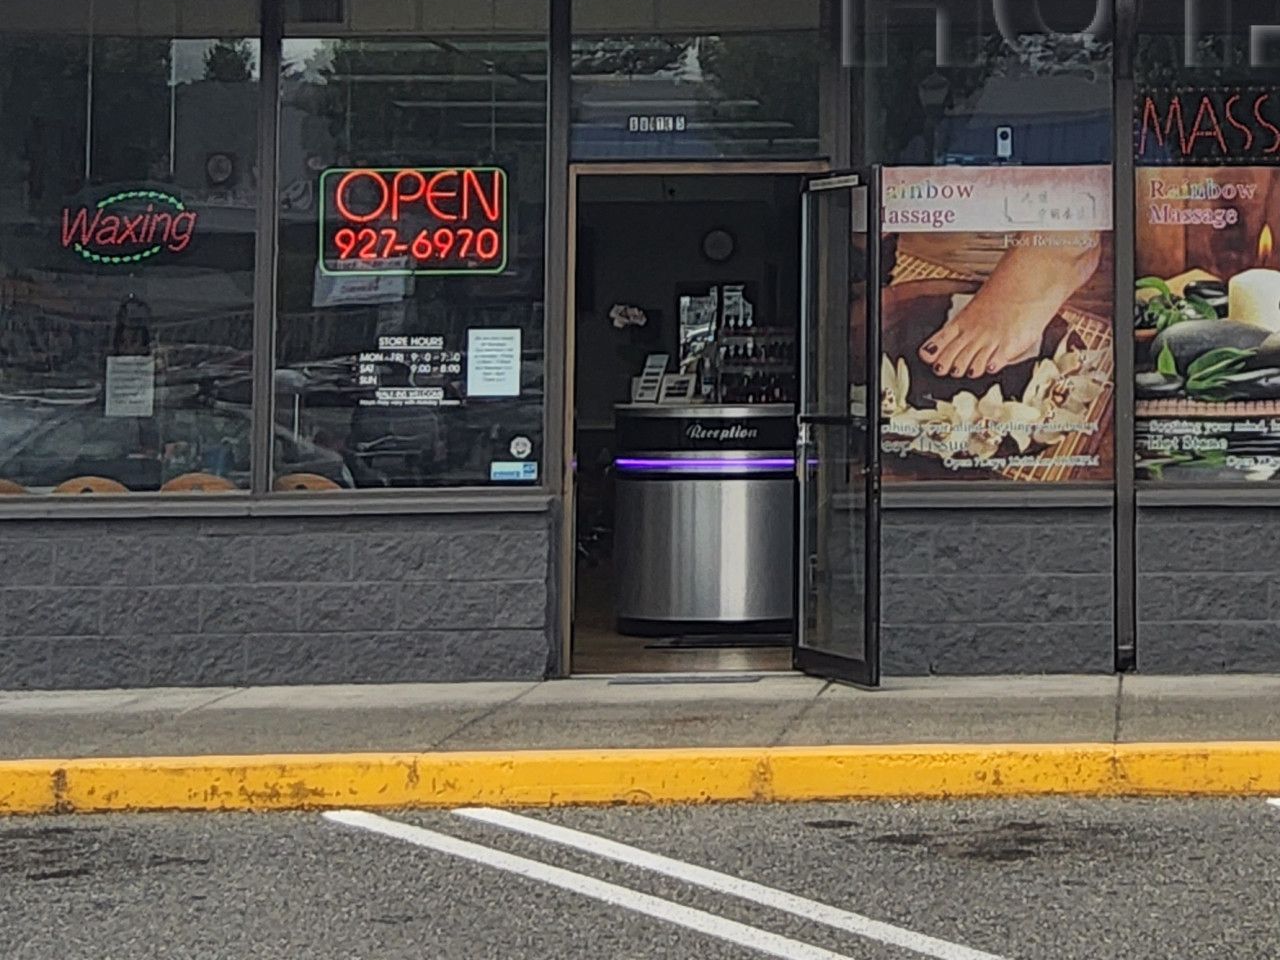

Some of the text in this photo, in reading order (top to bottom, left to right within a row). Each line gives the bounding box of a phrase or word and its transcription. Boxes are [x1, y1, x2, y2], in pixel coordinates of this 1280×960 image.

[336, 170, 499, 222] OPEN
[886, 180, 974, 200] ainbow
[1149, 177, 1257, 200] Rainbow
[61, 203, 197, 252] Waxing
[1149, 203, 1239, 228] Massage
[335, 228, 499, 260] 927-6970
[379, 336, 443, 346] STORE HOURS
[686, 424, 758, 440] Reception
